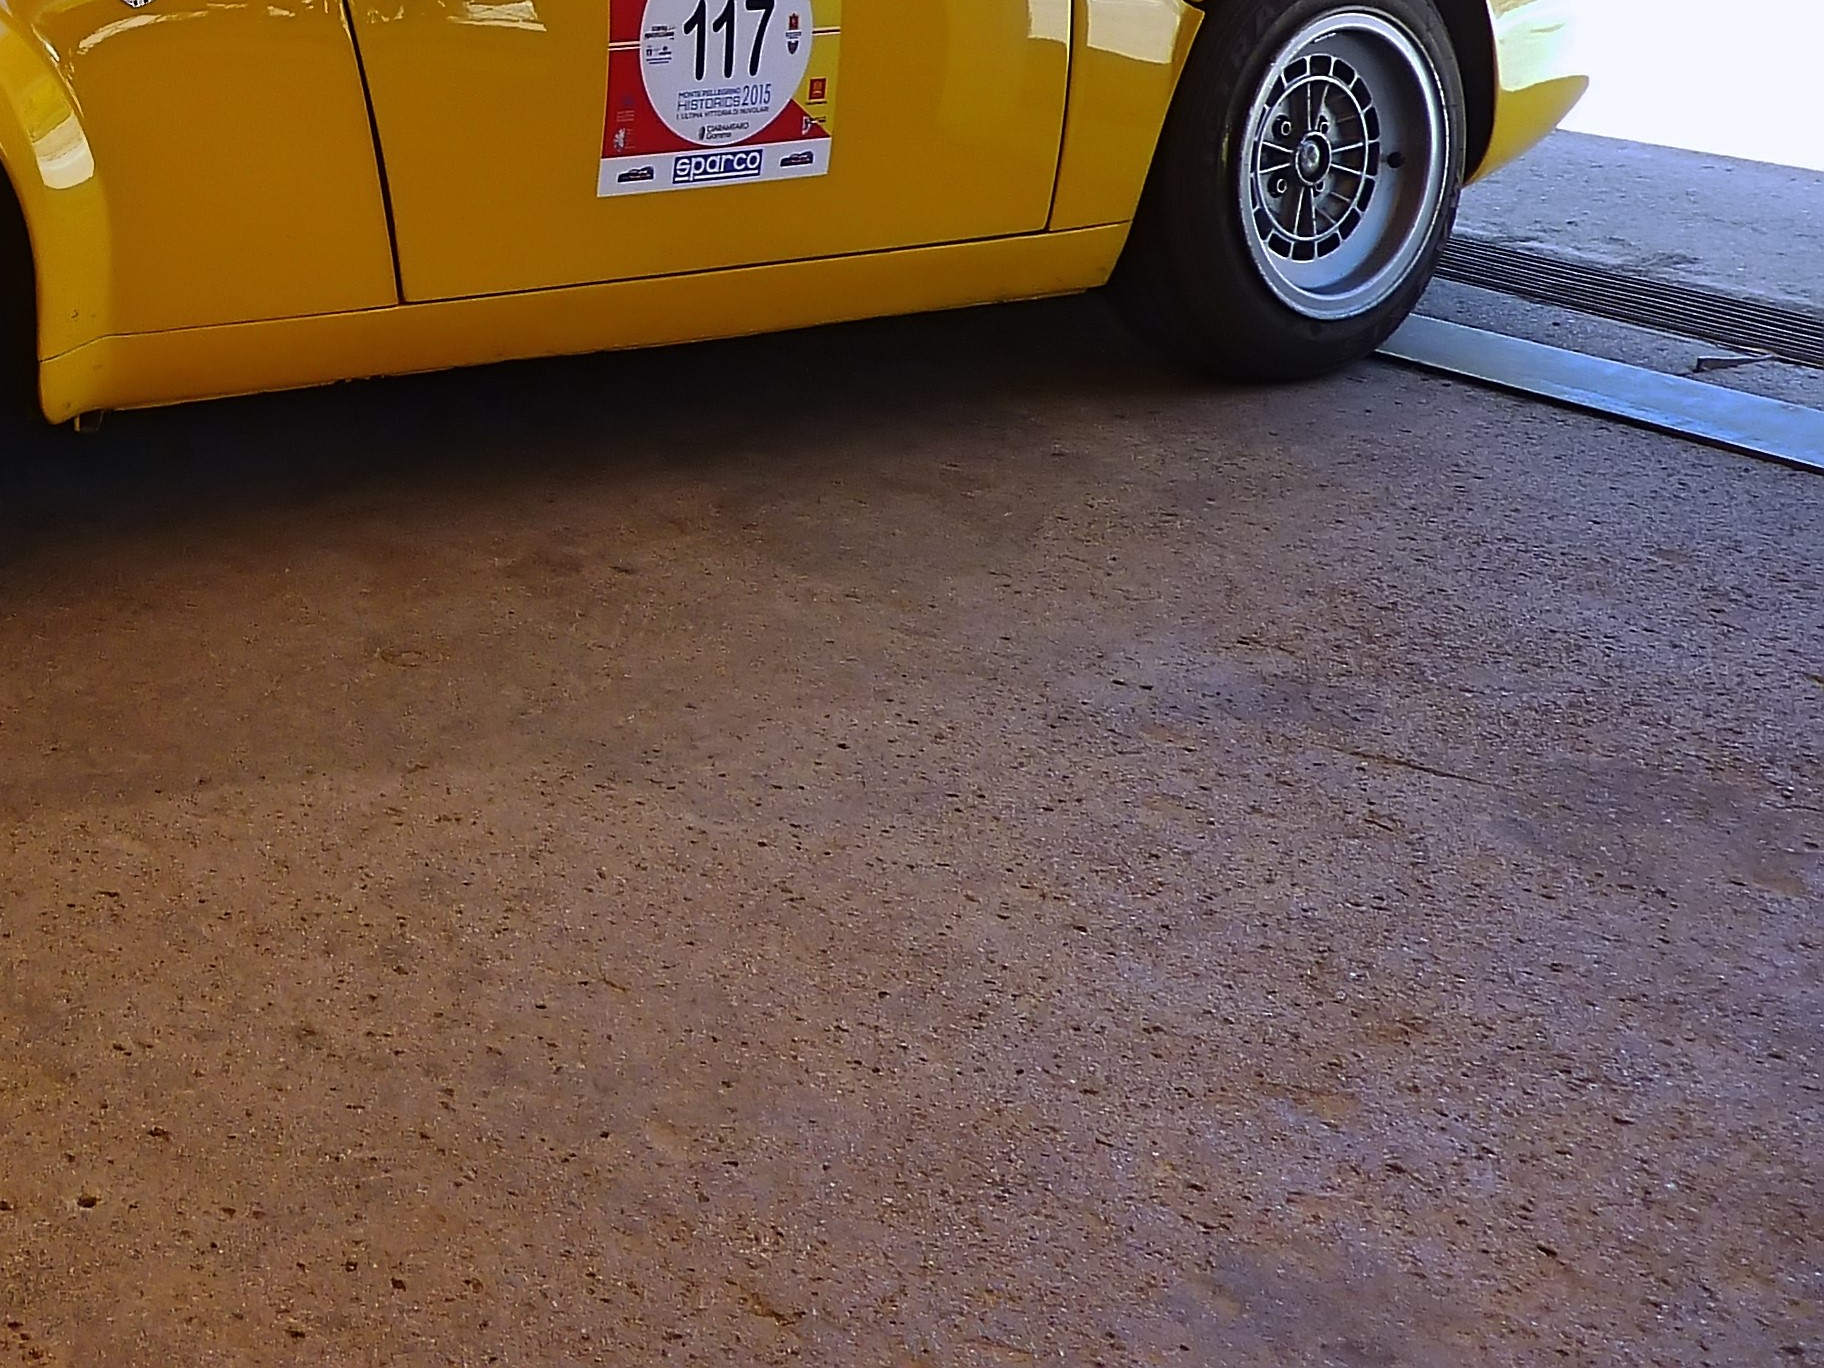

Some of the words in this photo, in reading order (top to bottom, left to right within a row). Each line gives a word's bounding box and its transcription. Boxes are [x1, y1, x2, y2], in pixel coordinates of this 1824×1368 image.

[677, 96, 741, 111] HISTORICS
[742, 83, 771, 106] 2015
[675, 151, 760, 180] sparco
